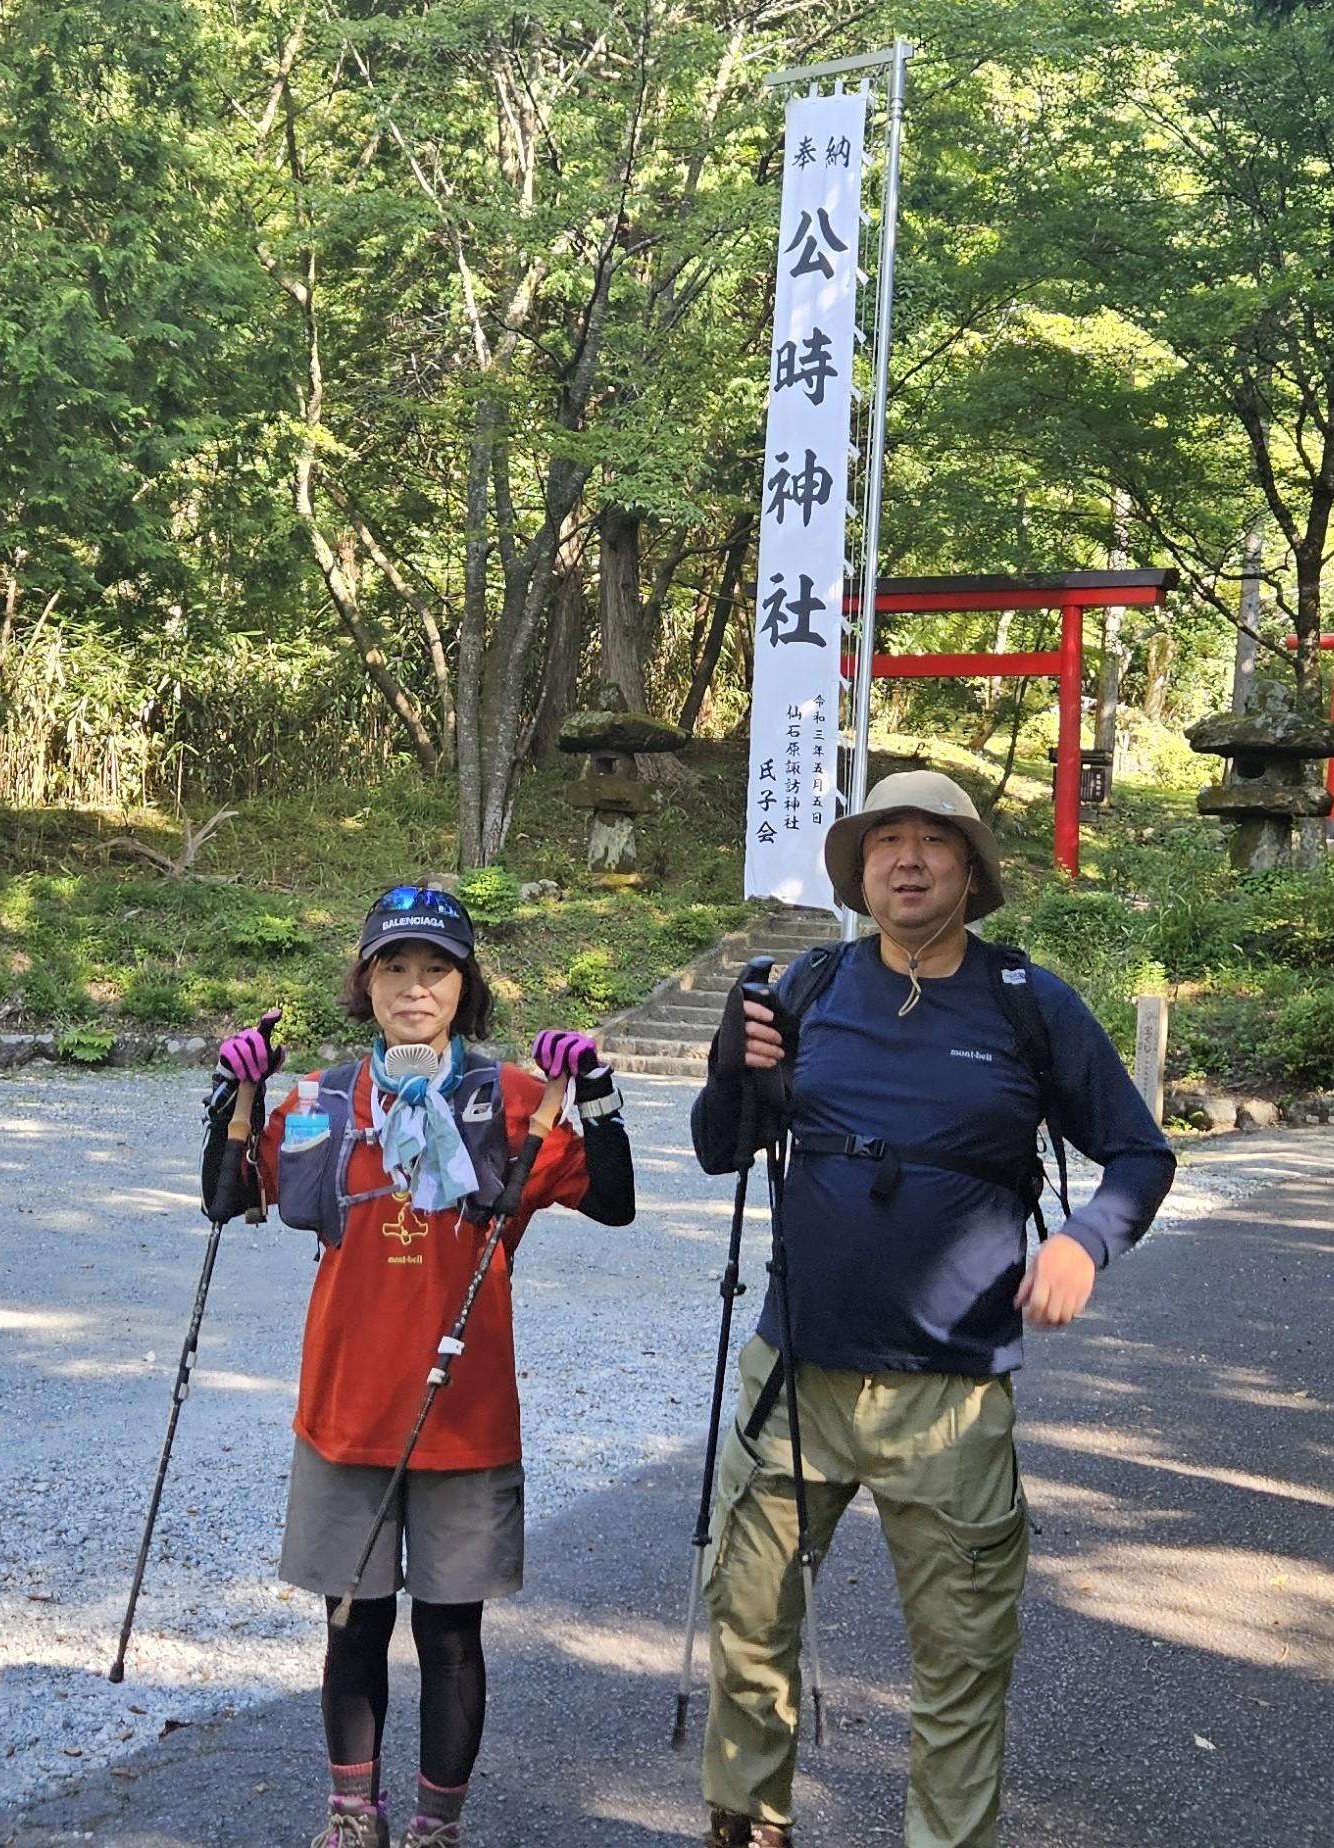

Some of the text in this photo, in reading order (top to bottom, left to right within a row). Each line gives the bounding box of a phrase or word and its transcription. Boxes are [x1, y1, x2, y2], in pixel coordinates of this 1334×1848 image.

[791, 135, 851, 171] 奉納
[759, 207, 849, 648] 公時神社
[755, 758, 778, 844] 氏子会
[784, 704, 802, 830] 仙石原諏訪神社
[812, 694, 826, 825] 令和三年五月五日
[382, 916, 445, 931] BALENCIAGA
